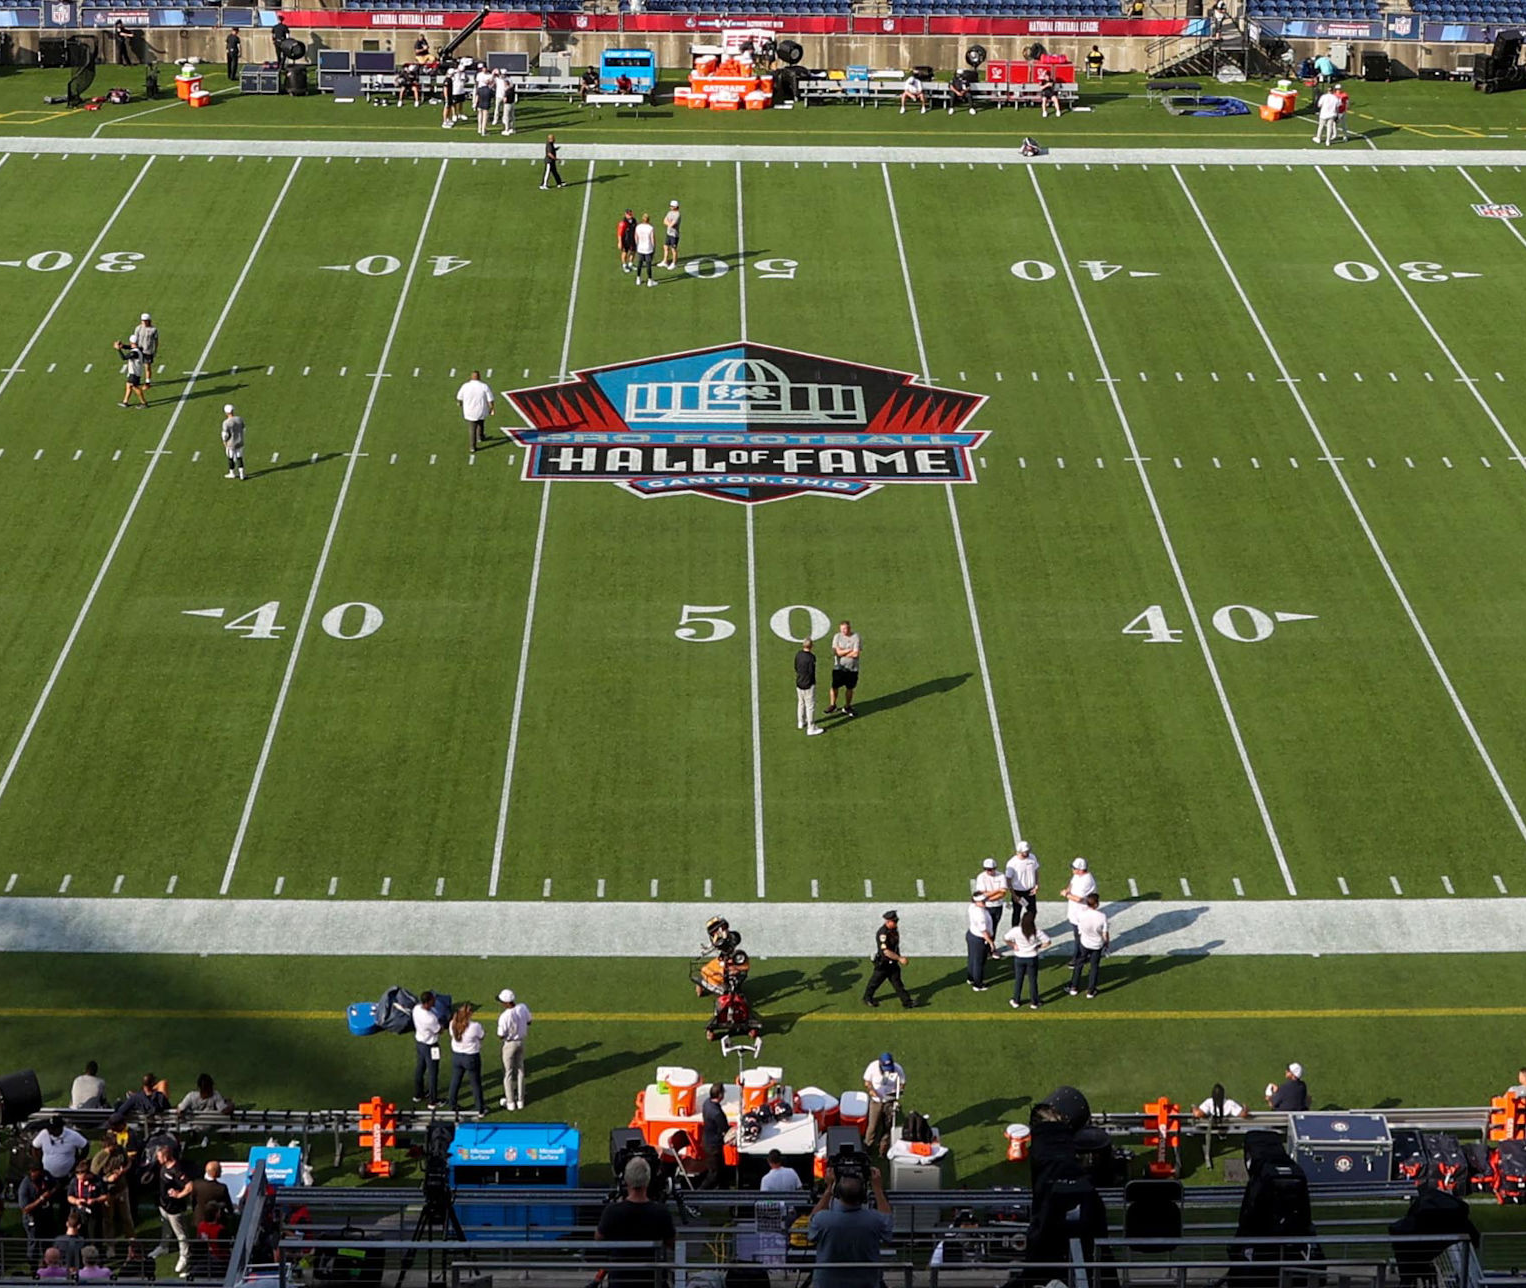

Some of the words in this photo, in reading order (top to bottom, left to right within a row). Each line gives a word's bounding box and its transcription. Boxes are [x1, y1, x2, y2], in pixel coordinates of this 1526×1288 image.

[703, 85, 746, 93] GATORADE
[538, 431, 651, 445] PRO
[673, 432, 960, 446] FOOTBALL
[549, 447, 727, 474] HALL
[729, 449, 771, 466] OF
[773, 448, 951, 475] FAME
[784, 477, 852, 491] OHIO
[373, 1124, 381, 1162] GATORADE
